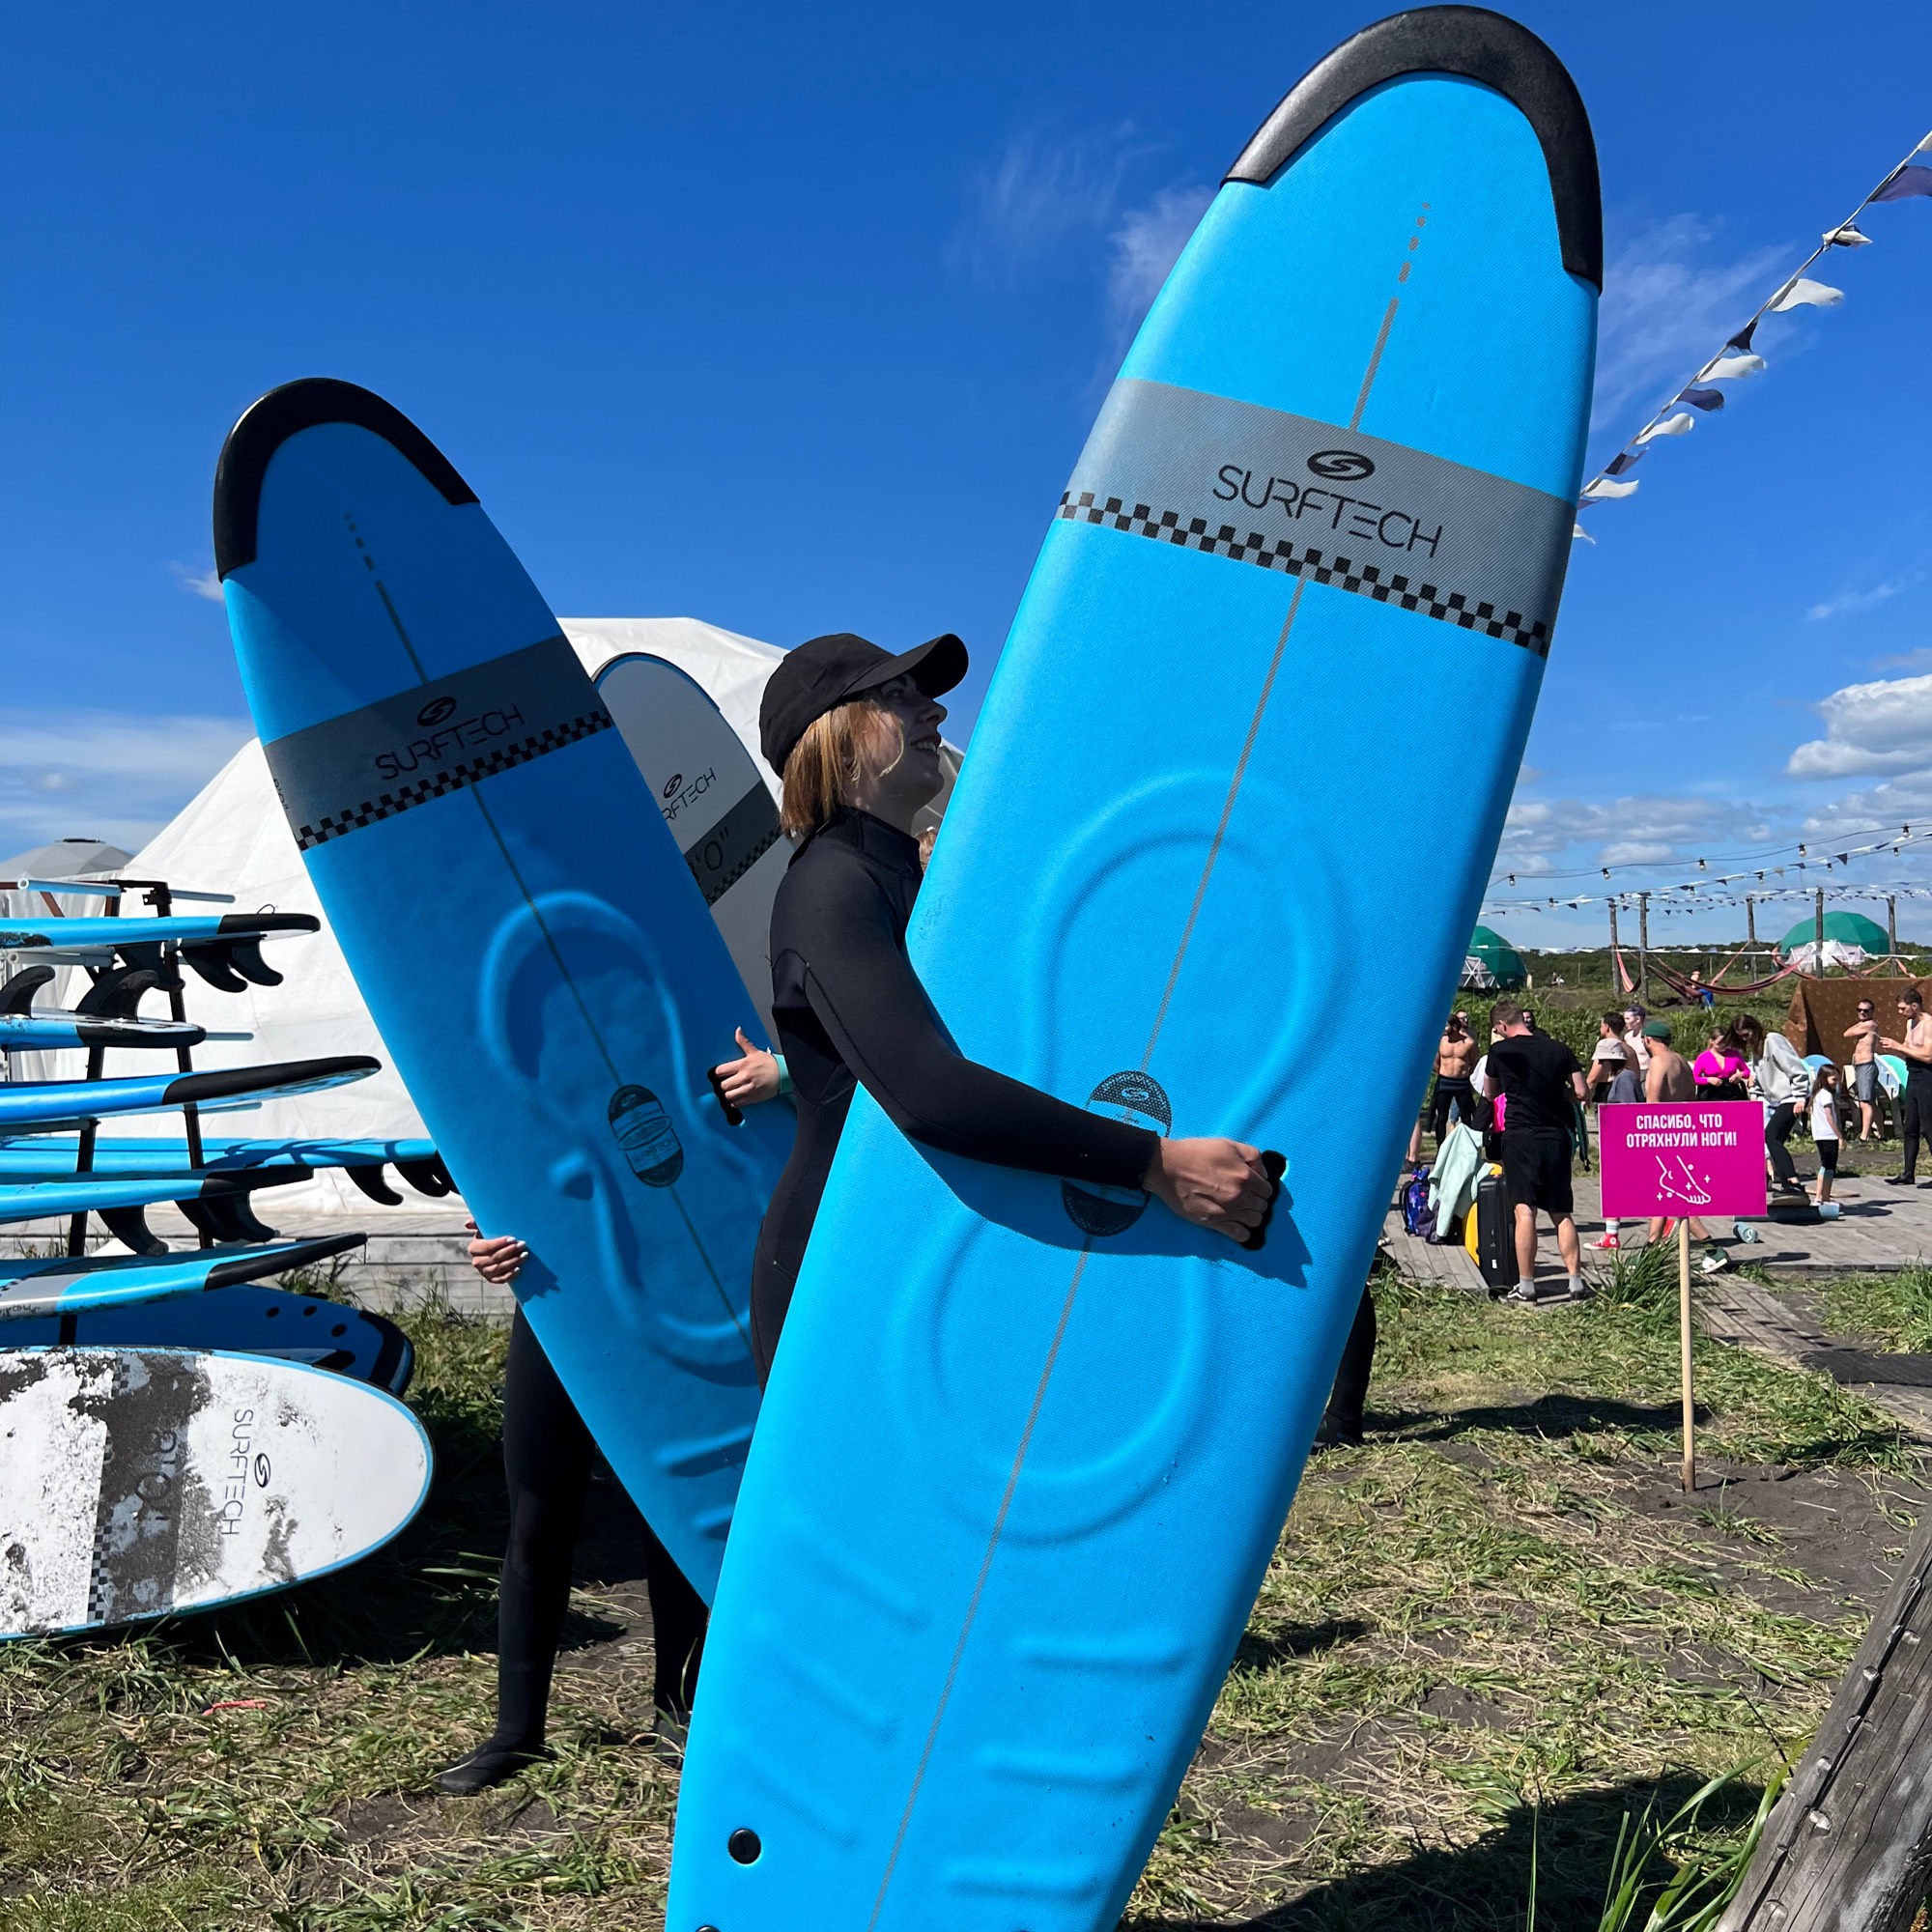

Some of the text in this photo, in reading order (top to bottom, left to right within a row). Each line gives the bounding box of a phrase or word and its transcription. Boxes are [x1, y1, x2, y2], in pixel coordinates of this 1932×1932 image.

[1212, 465, 1443, 557] SURFTECH
[375, 703, 526, 781] SURFTECH
[662, 767, 717, 820] RFTECH
[687, 826, 730, 882] '0"
[1626, 1131, 1738, 1148] ОТРЯХНУЛИ НОГИ!
[1635, 1114, 1722, 1130] СПАСИБО, ЧТО
[221, 1409, 254, 1535] SURFTECH
